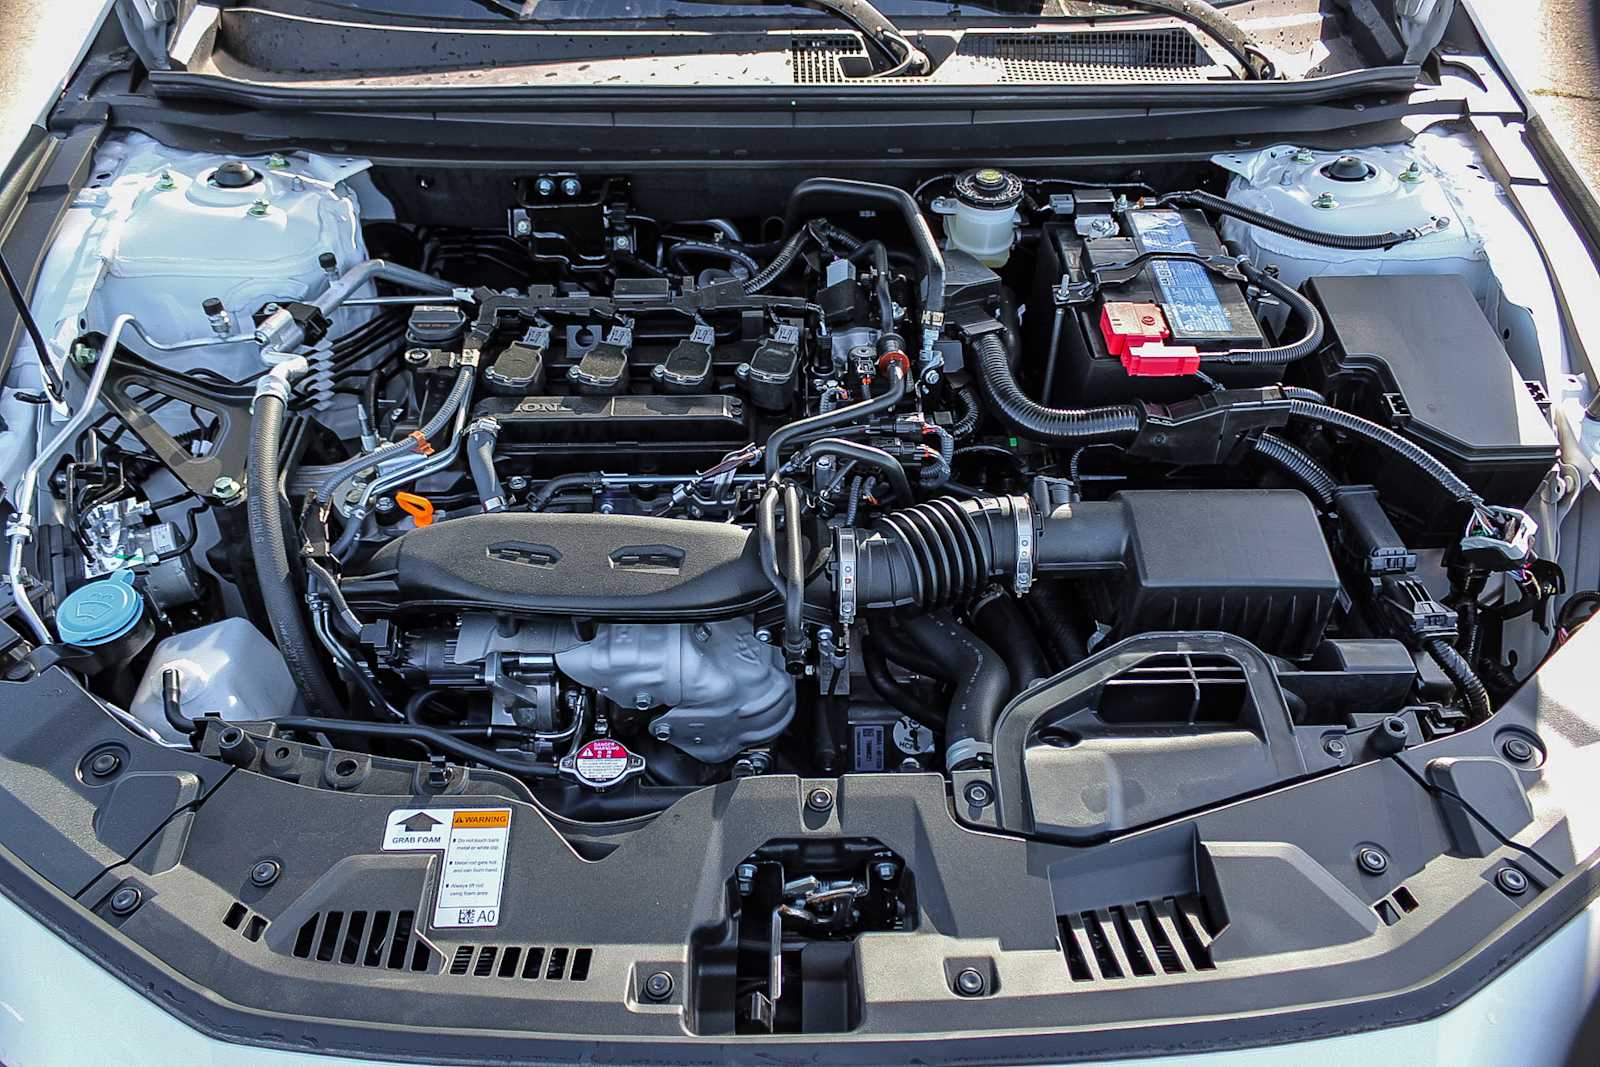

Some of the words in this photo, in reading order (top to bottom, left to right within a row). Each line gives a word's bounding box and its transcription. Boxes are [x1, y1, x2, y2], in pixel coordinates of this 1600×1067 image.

[464, 815, 507, 823] WARNING
[392, 836, 415, 844] GRAB
[417, 836, 441, 844] FOAM
[477, 910, 496, 923] A0
